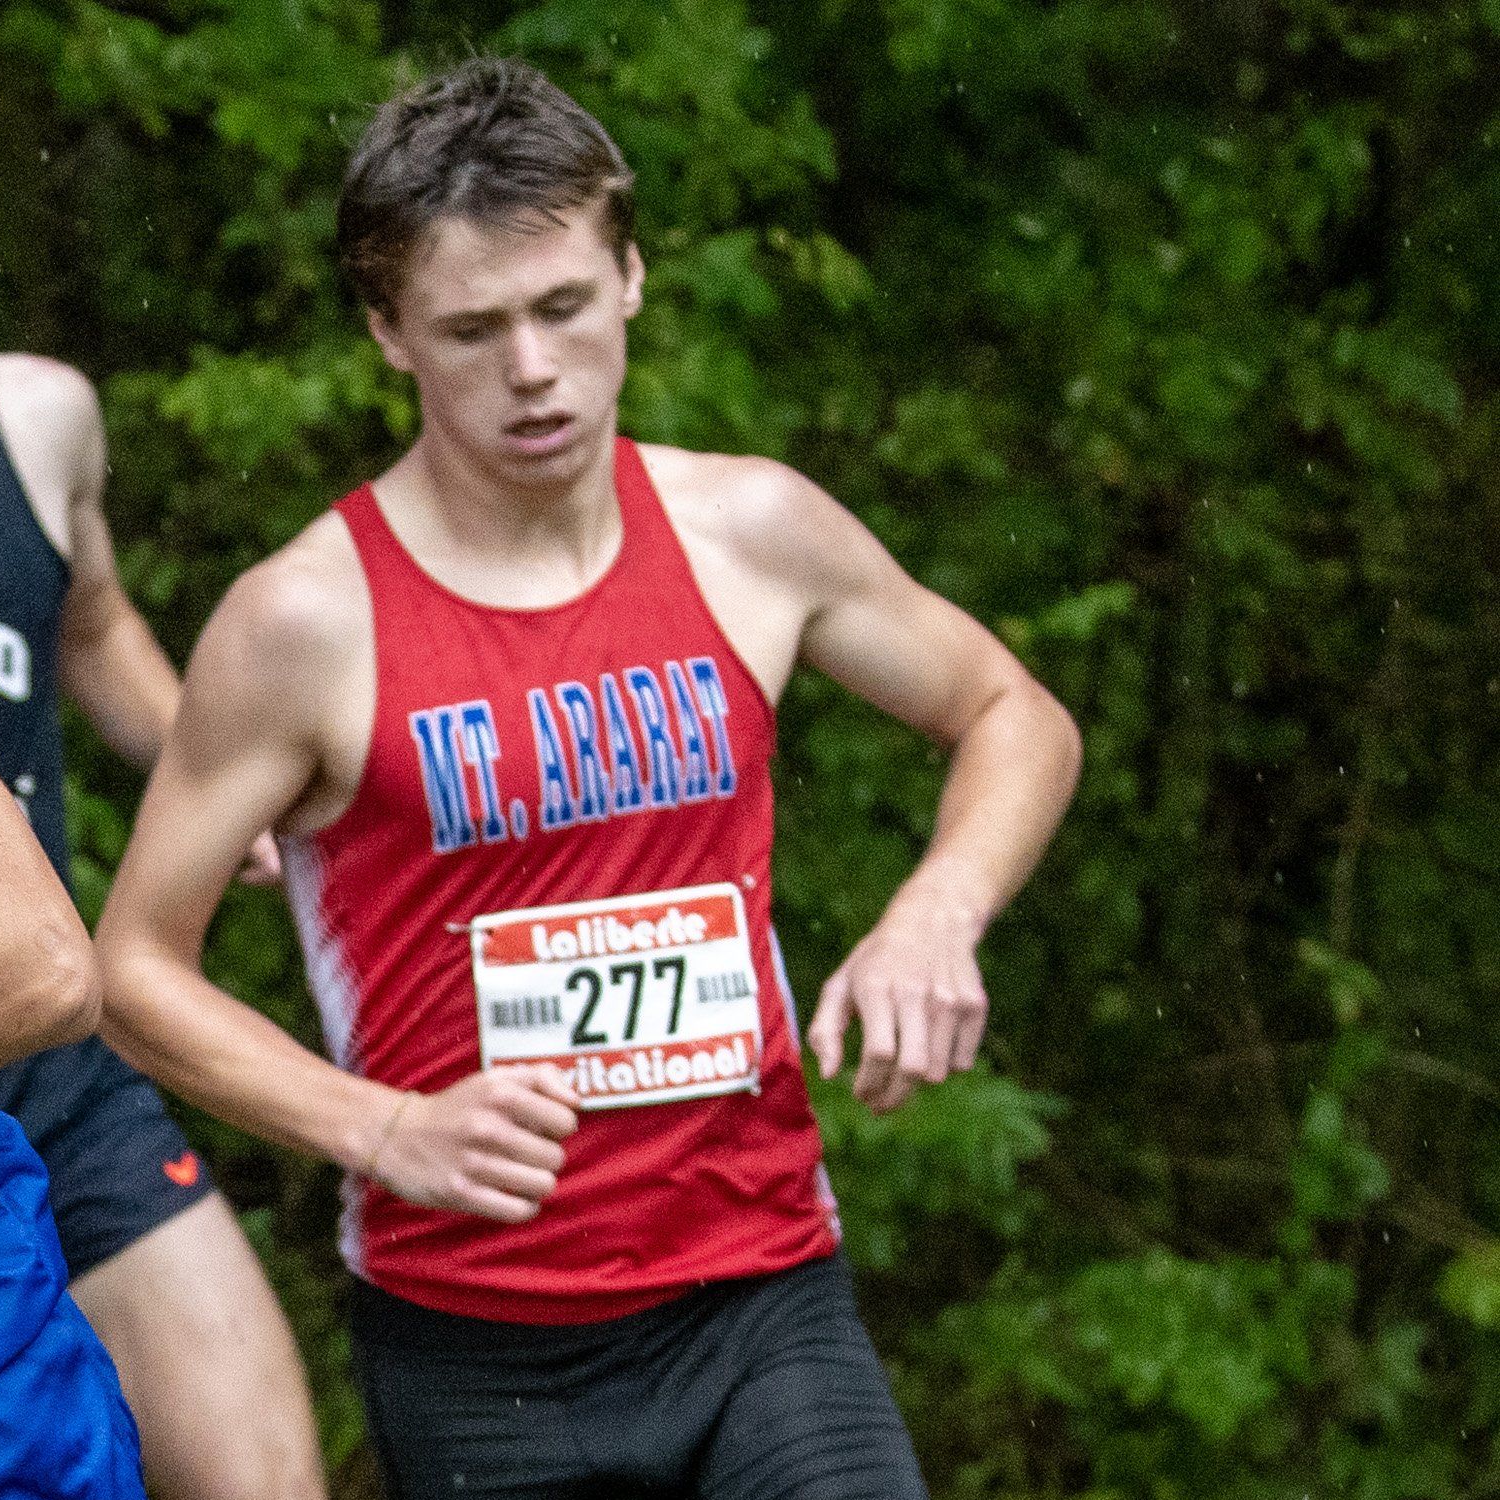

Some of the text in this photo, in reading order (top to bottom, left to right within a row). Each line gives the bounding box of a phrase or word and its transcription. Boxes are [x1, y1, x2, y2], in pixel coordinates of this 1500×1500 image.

[408, 656, 737, 854] MT. ARARAT
[564, 954, 687, 1046] 277
